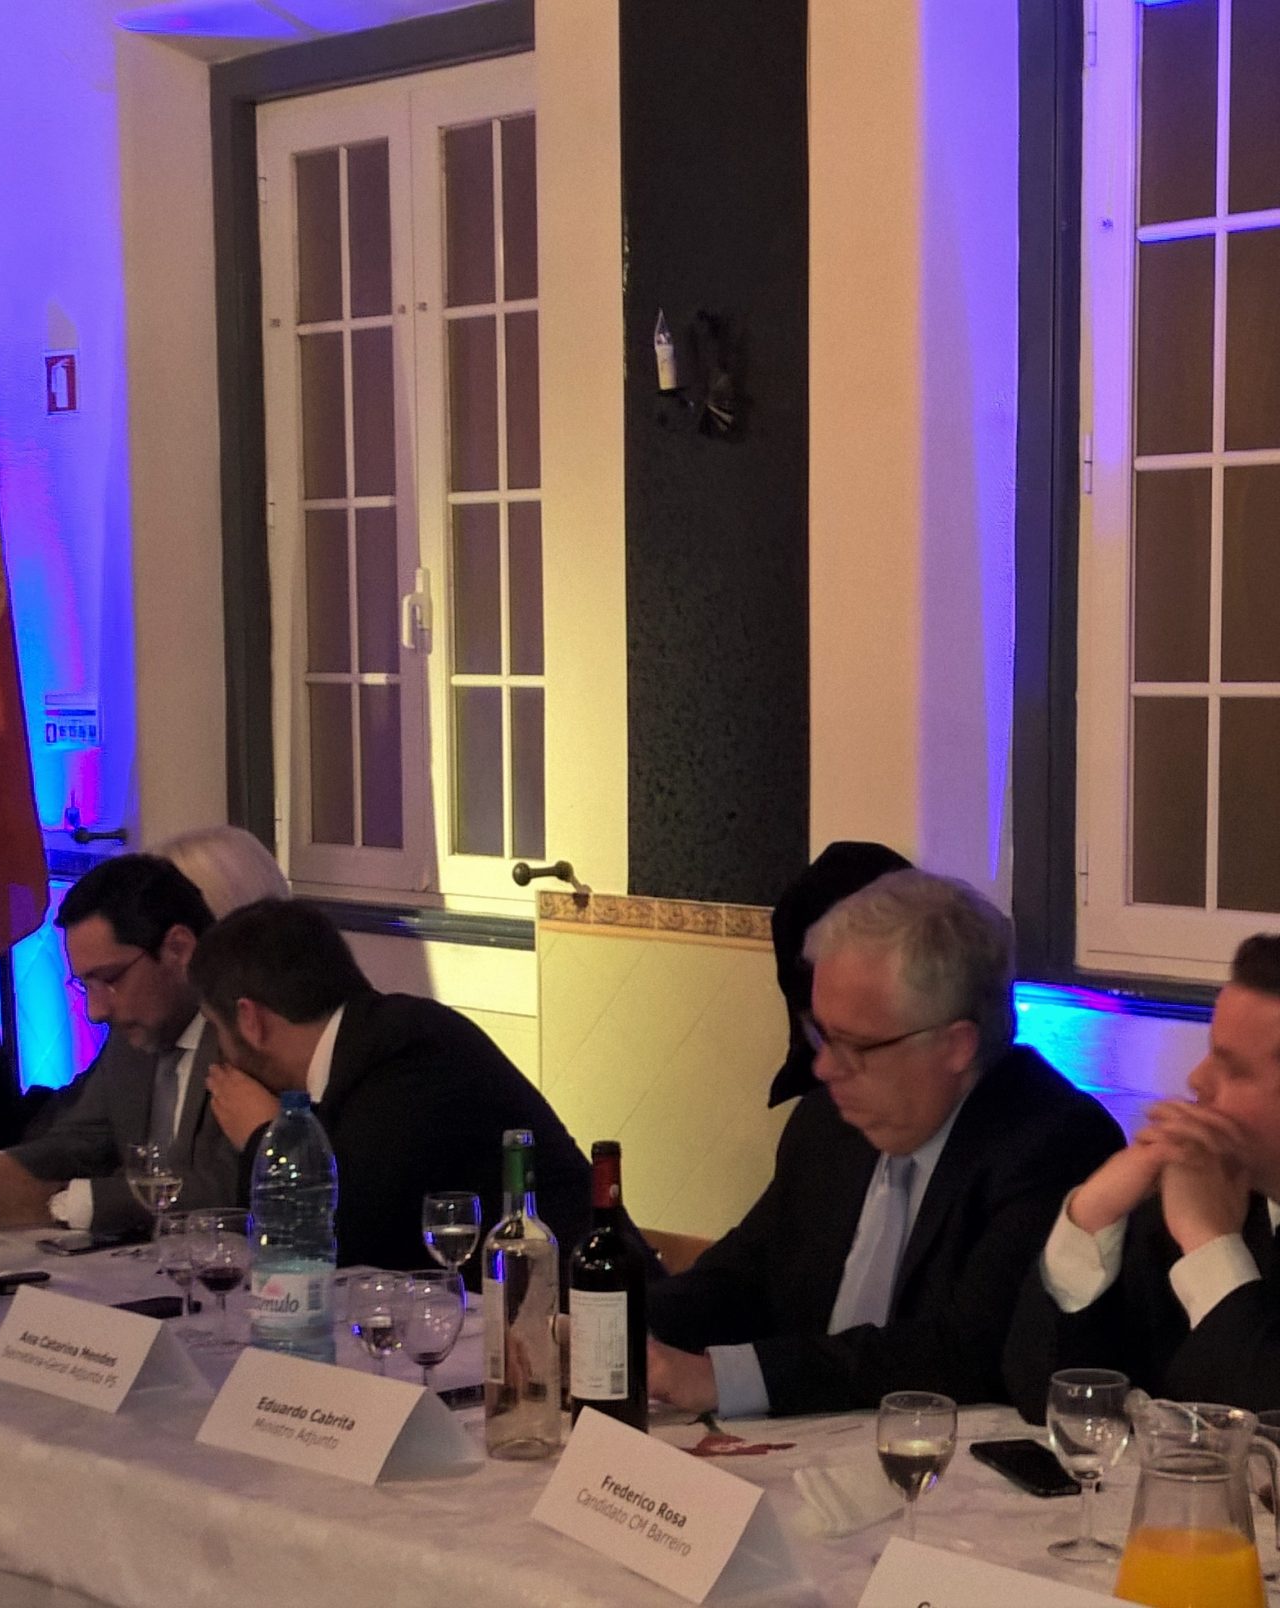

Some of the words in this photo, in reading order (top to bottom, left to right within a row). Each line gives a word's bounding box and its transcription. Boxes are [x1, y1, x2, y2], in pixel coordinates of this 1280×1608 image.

[252, 1417, 294, 1439] Ministro
[295, 1428, 340, 1450] Adjunto
[256, 1396, 308, 1419] Eduardo
[310, 1408, 356, 1431] Cabrita
[577, 1488, 627, 1524] Candidato
[628, 1514, 648, 1535] CM
[647, 1523, 692, 1557] Barreiro
[601, 1475, 655, 1513] Frederico
[656, 1502, 687, 1528] Rosa
